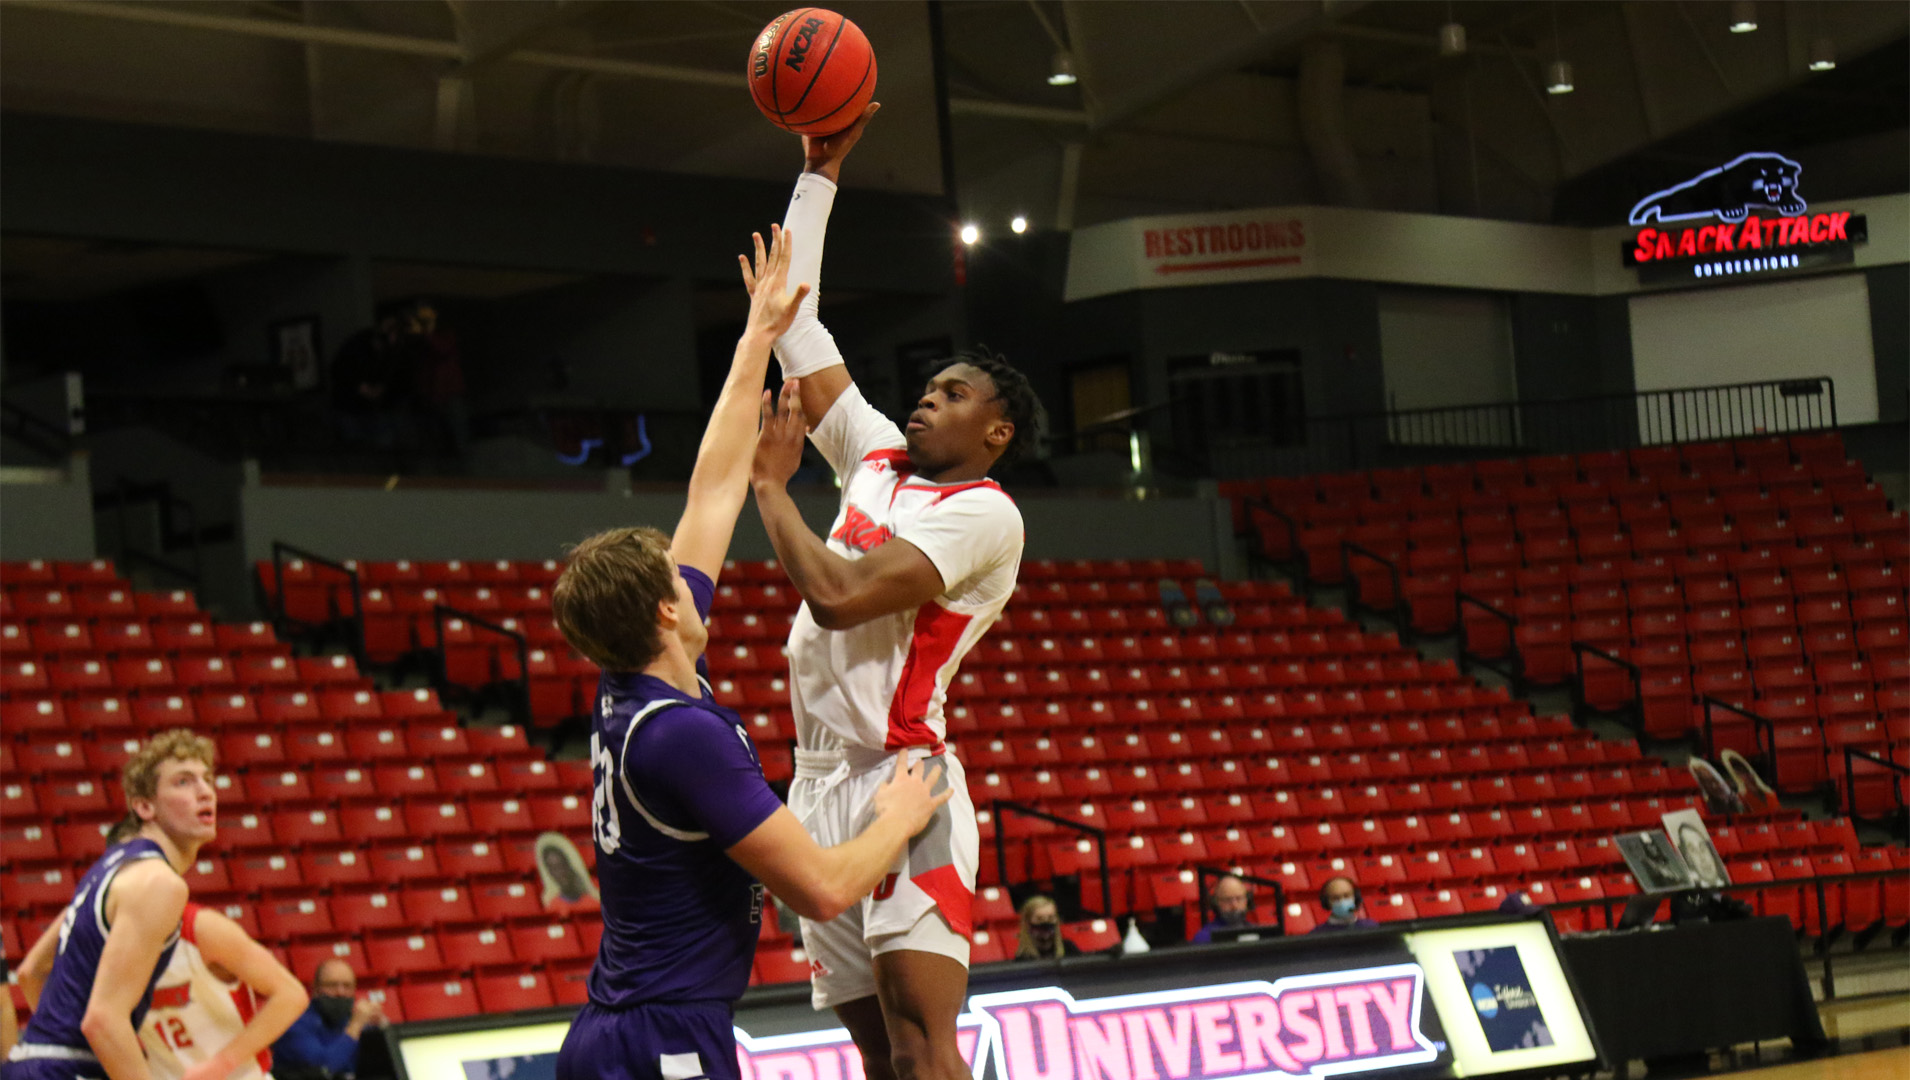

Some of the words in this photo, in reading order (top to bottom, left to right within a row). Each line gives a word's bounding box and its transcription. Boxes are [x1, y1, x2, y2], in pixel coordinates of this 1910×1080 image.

[785, 17, 825, 73] NCAA
[1144, 219, 1306, 259] RESTROOMS
[1694, 254, 1799, 278] CONCESSIONS
[154, 1017, 194, 1053] 12
[998, 979, 1416, 1080] UNIVERSITY
